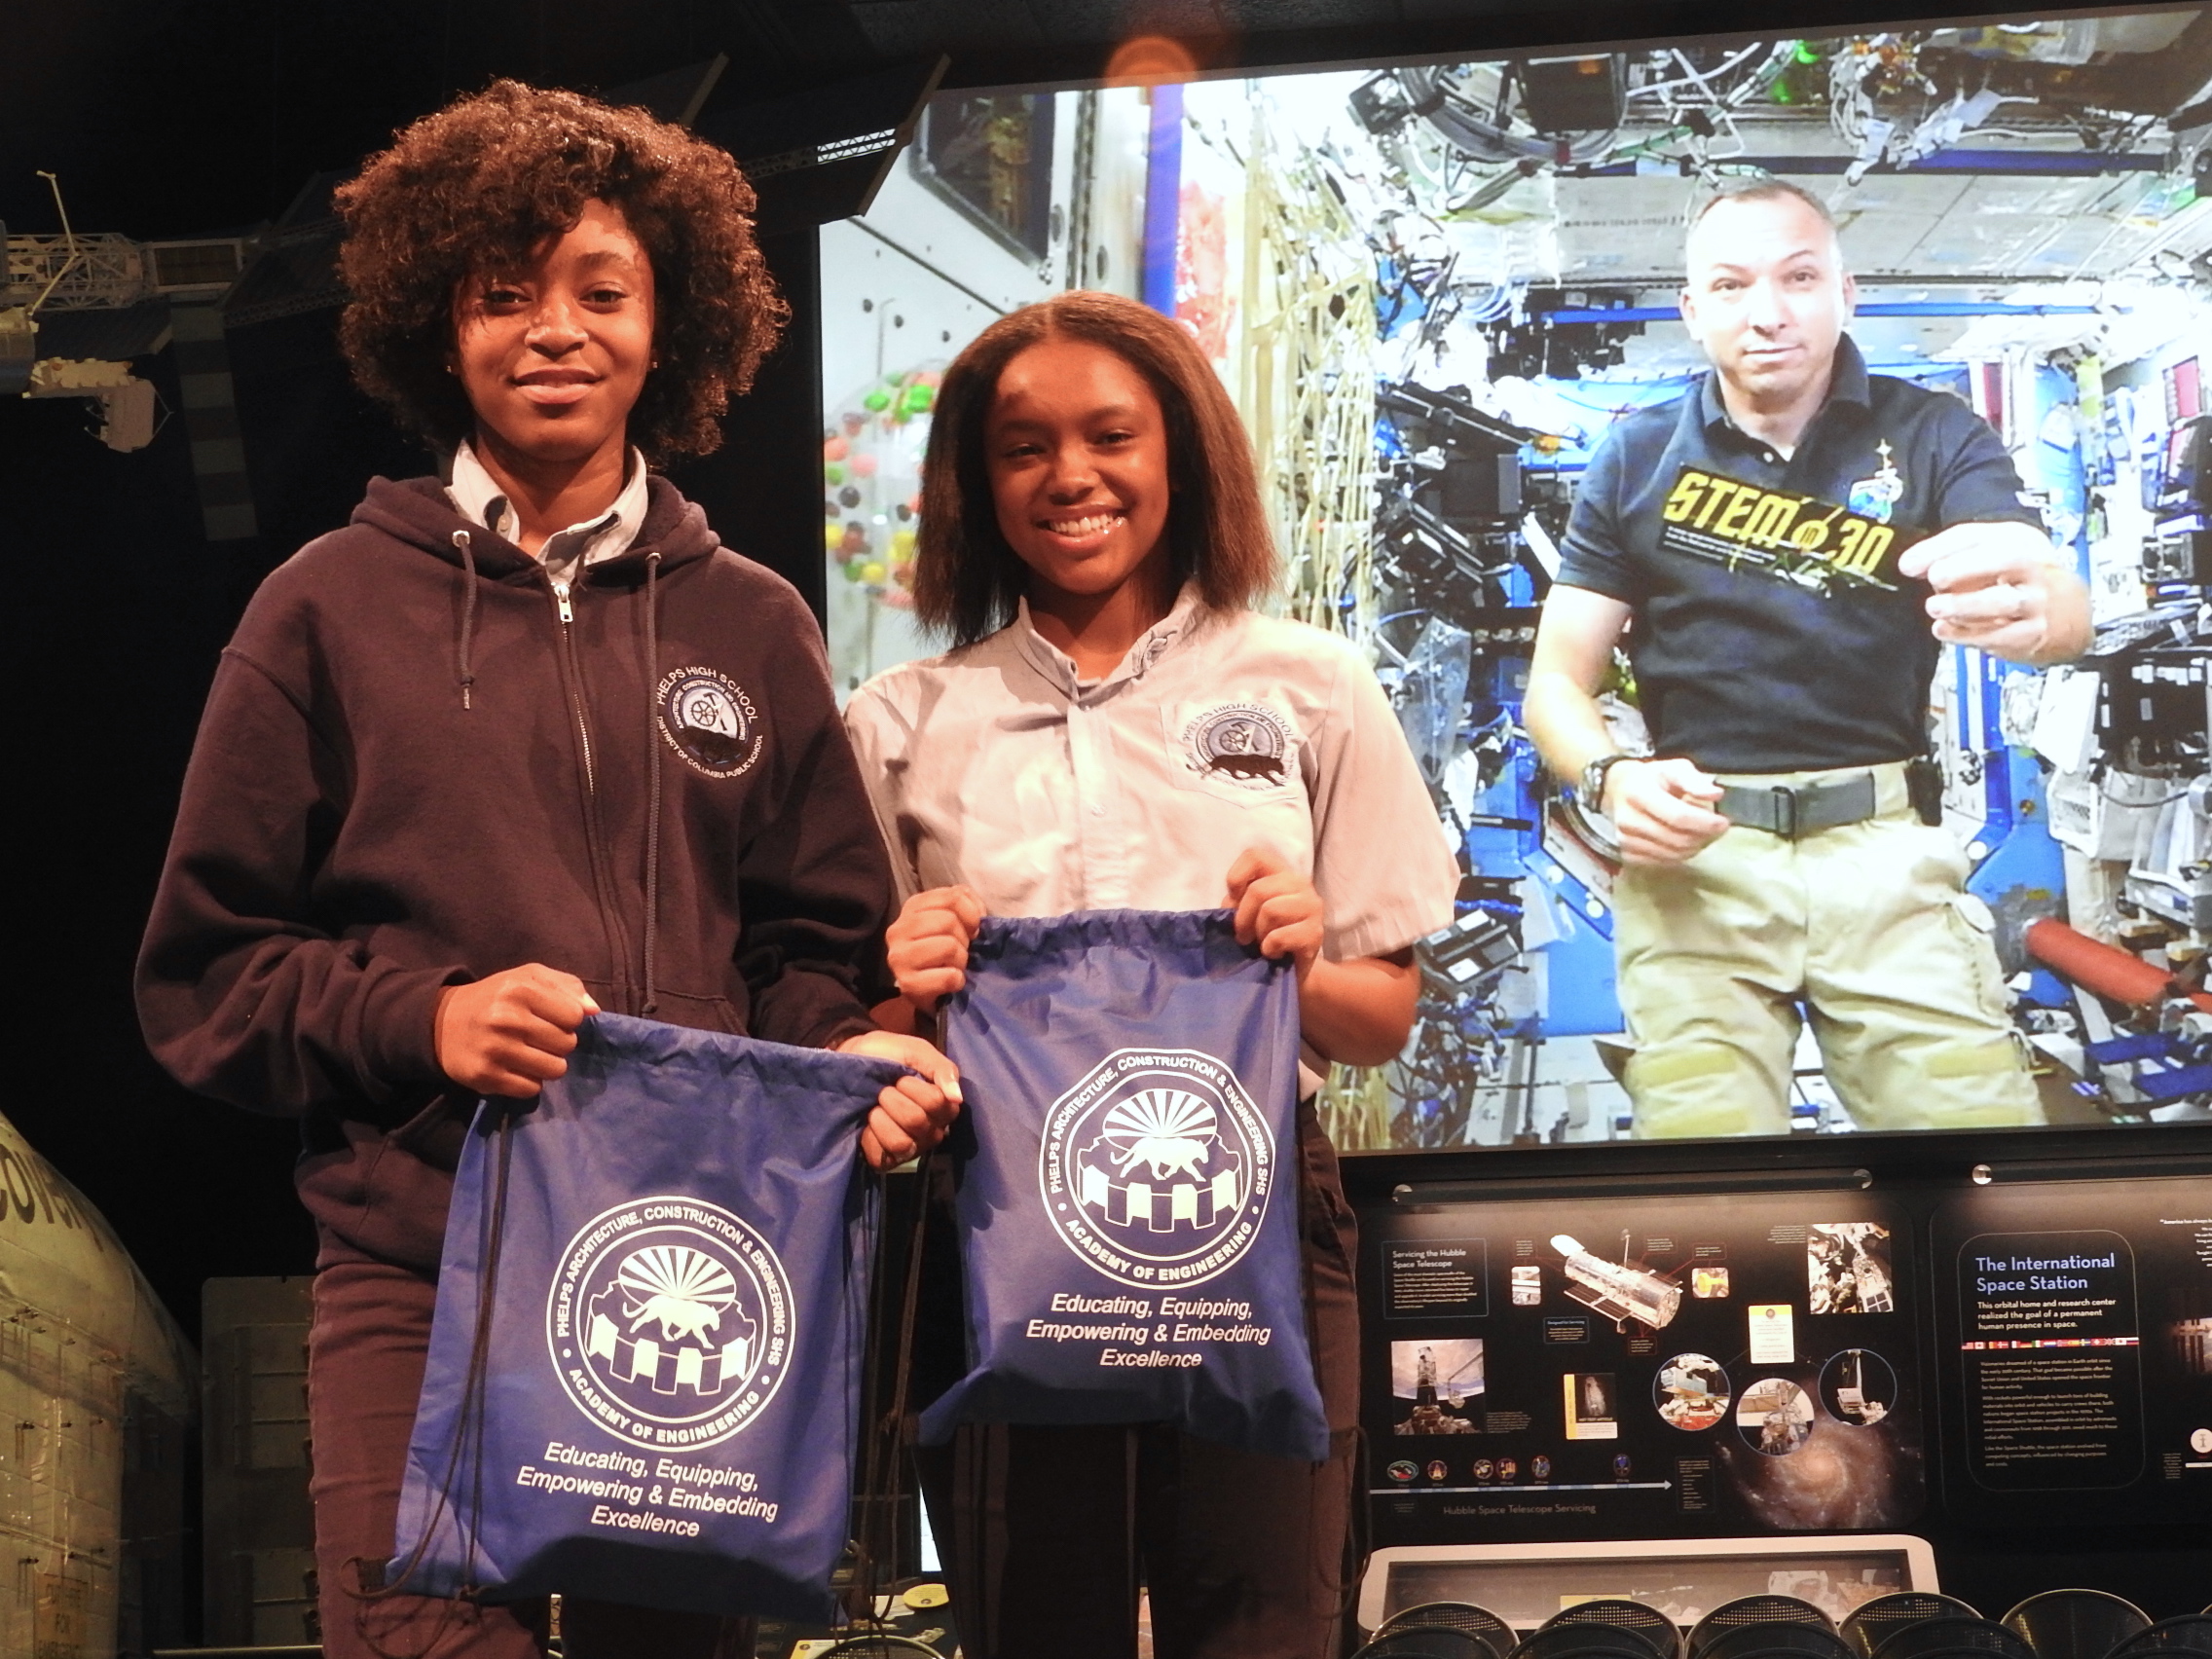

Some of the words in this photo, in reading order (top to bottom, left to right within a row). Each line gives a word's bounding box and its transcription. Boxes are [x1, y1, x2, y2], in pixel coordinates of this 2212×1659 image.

[1663, 471, 1800, 549] STEM
[1830, 518, 1895, 575] 30
[656, 668, 685, 706] PHELPS
[685, 666, 717, 678] HIGH
[719, 673, 758, 724] SCHOOL
[1182, 712, 1212, 741] PHELPS
[1213, 703, 1246, 714] HIGH
[1250, 704, 1294, 737] SCHOOL
[656, 716, 680, 751] DISTRICT
[677, 750, 688, 760] OF
[687, 757, 726, 779] COLUMBIA
[726, 762, 751, 778] PUBLIC
[1117, 1055, 1218, 1080] CONSTRUCTION
[1217, 1075, 1227, 1088] &
[1051, 1066, 1119, 1140] ARCHITECTURE,
[1224, 1085, 1269, 1165] ENGINEERING
[1049, 1142, 1063, 1195] PHELPS
[1255, 1167, 1269, 1196] SHS
[644, 1205, 745, 1245] CONSTRUCTION
[566, 1211, 644, 1283] ARCHITECTURE,
[742, 1240, 754, 1254] &
[1065, 1219, 1132, 1273] ACADEMY
[1132, 1266, 1155, 1280] OF
[1158, 1222, 1252, 1281] ENGINEERING
[1392, 1249, 1426, 1260] Servicing
[1440, 1248, 1467, 1257] Hubble
[1975, 1256, 2007, 1272] The
[2010, 1252, 2115, 1271] International
[1392, 1260, 1416, 1270] Space
[1417, 1259, 1454, 1269] Telescope
[750, 1249, 786, 1335] ENGINEERING
[1976, 1276, 2026, 1296] Space
[2029, 1274, 2088, 1291] Station
[557, 1281, 574, 1338] PHELPS
[1051, 1293, 1154, 1318] Educating,
[1160, 1297, 1253, 1321] Equipping,
[1977, 1301, 1993, 1309] This
[1994, 1300, 2019, 1309] orbital
[2019, 1300, 2042, 1309] home
[2042, 1299, 2057, 1308] and
[2057, 1299, 2090, 1308] research
[2091, 1298, 2117, 1307] center
[1977, 1311, 2009, 1320] realized
[2024, 1310, 2042, 1320] goal
[2043, 1309, 2052, 1318] of
[2059, 1309, 2103, 1318] permanent
[1026, 1319, 1149, 1346] Empowering
[1153, 1325, 1168, 1343] &
[1172, 1325, 1271, 1346] Embedding
[2006, 1321, 2043, 1331] presence
[2052, 1320, 2079, 1329] space.
[767, 1337, 785, 1366] SHS
[1099, 1348, 1202, 1368] Excellence
[569, 1368, 631, 1429] ACADEMY
[631, 1422, 653, 1440] OF
[656, 1390, 760, 1444] ENGINEERING
[543, 1441, 649, 1479] Educating,
[655, 1456, 759, 1493] Equipping,
[516, 1466, 644, 1506] Empowering
[648, 1485, 664, 1504] &
[669, 1487, 779, 1523] Embedding
[1443, 1504, 1476, 1516] Hubble
[1478, 1503, 1506, 1515] Space
[1508, 1502, 1553, 1515] Telescope
[1554, 1501, 1597, 1515] Servicing
[590, 1505, 701, 1538] Excellence
